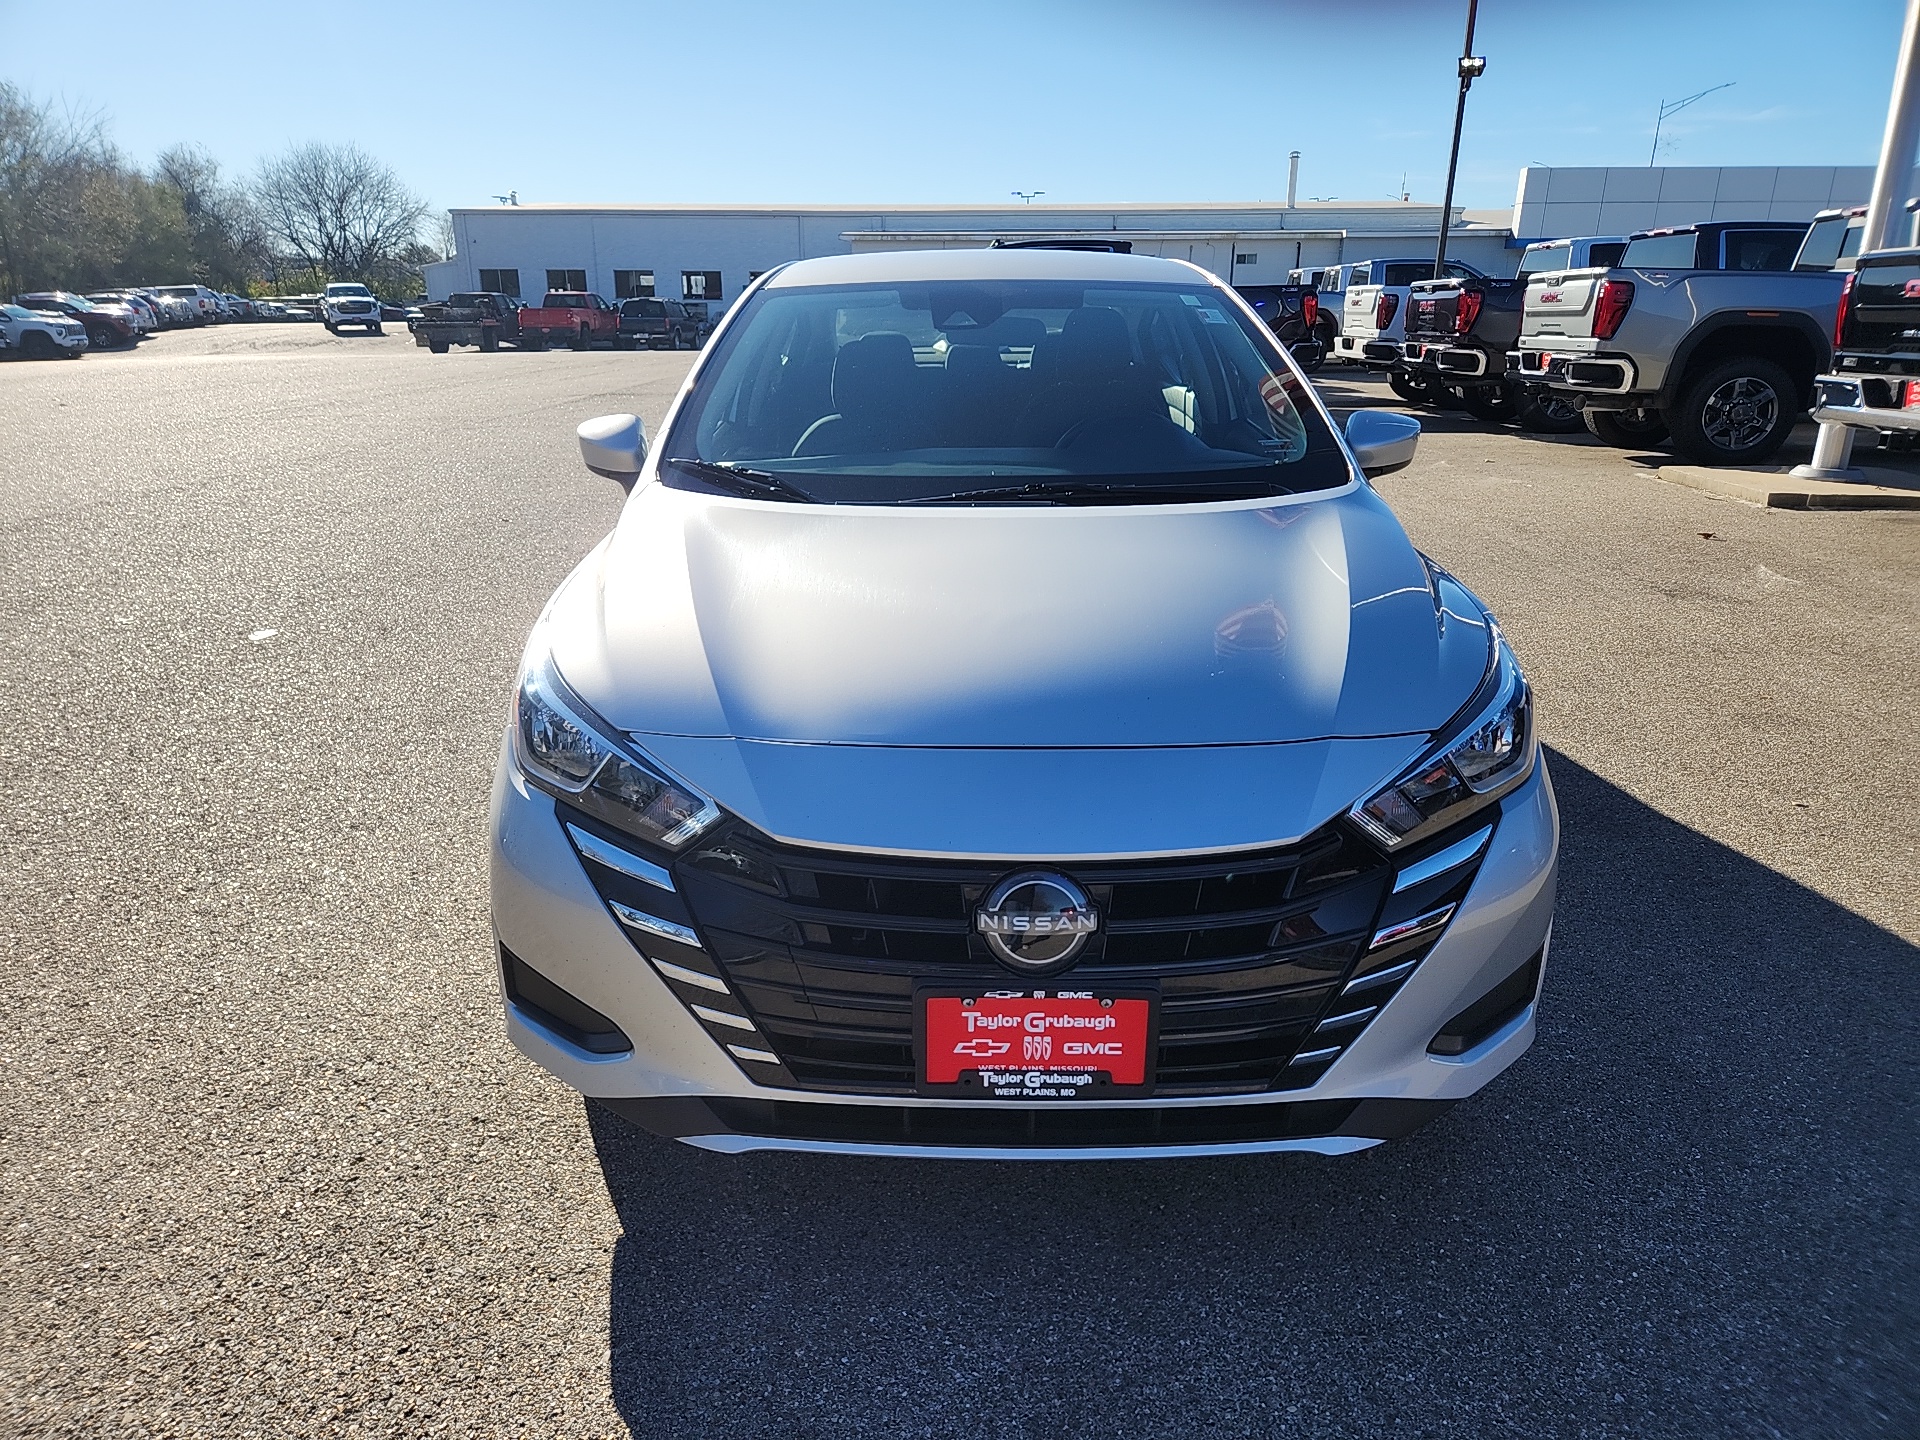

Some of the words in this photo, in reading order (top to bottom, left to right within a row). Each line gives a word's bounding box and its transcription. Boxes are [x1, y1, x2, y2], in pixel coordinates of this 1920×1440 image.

[980, 913, 1095, 931] NISSAN
[1057, 991, 1093, 999] GMC
[961, 1012, 1021, 1032] Taylor
[1023, 1012, 1116, 1033] Grubaugh
[1063, 1042, 1123, 1055] GMC
[978, 1071, 1023, 1087] Taylor
[1024, 1071, 1093, 1087] Grubaugh
[994, 1088, 1021, 1096] WEST
[1022, 1088, 1059, 1097] PLAINS,
